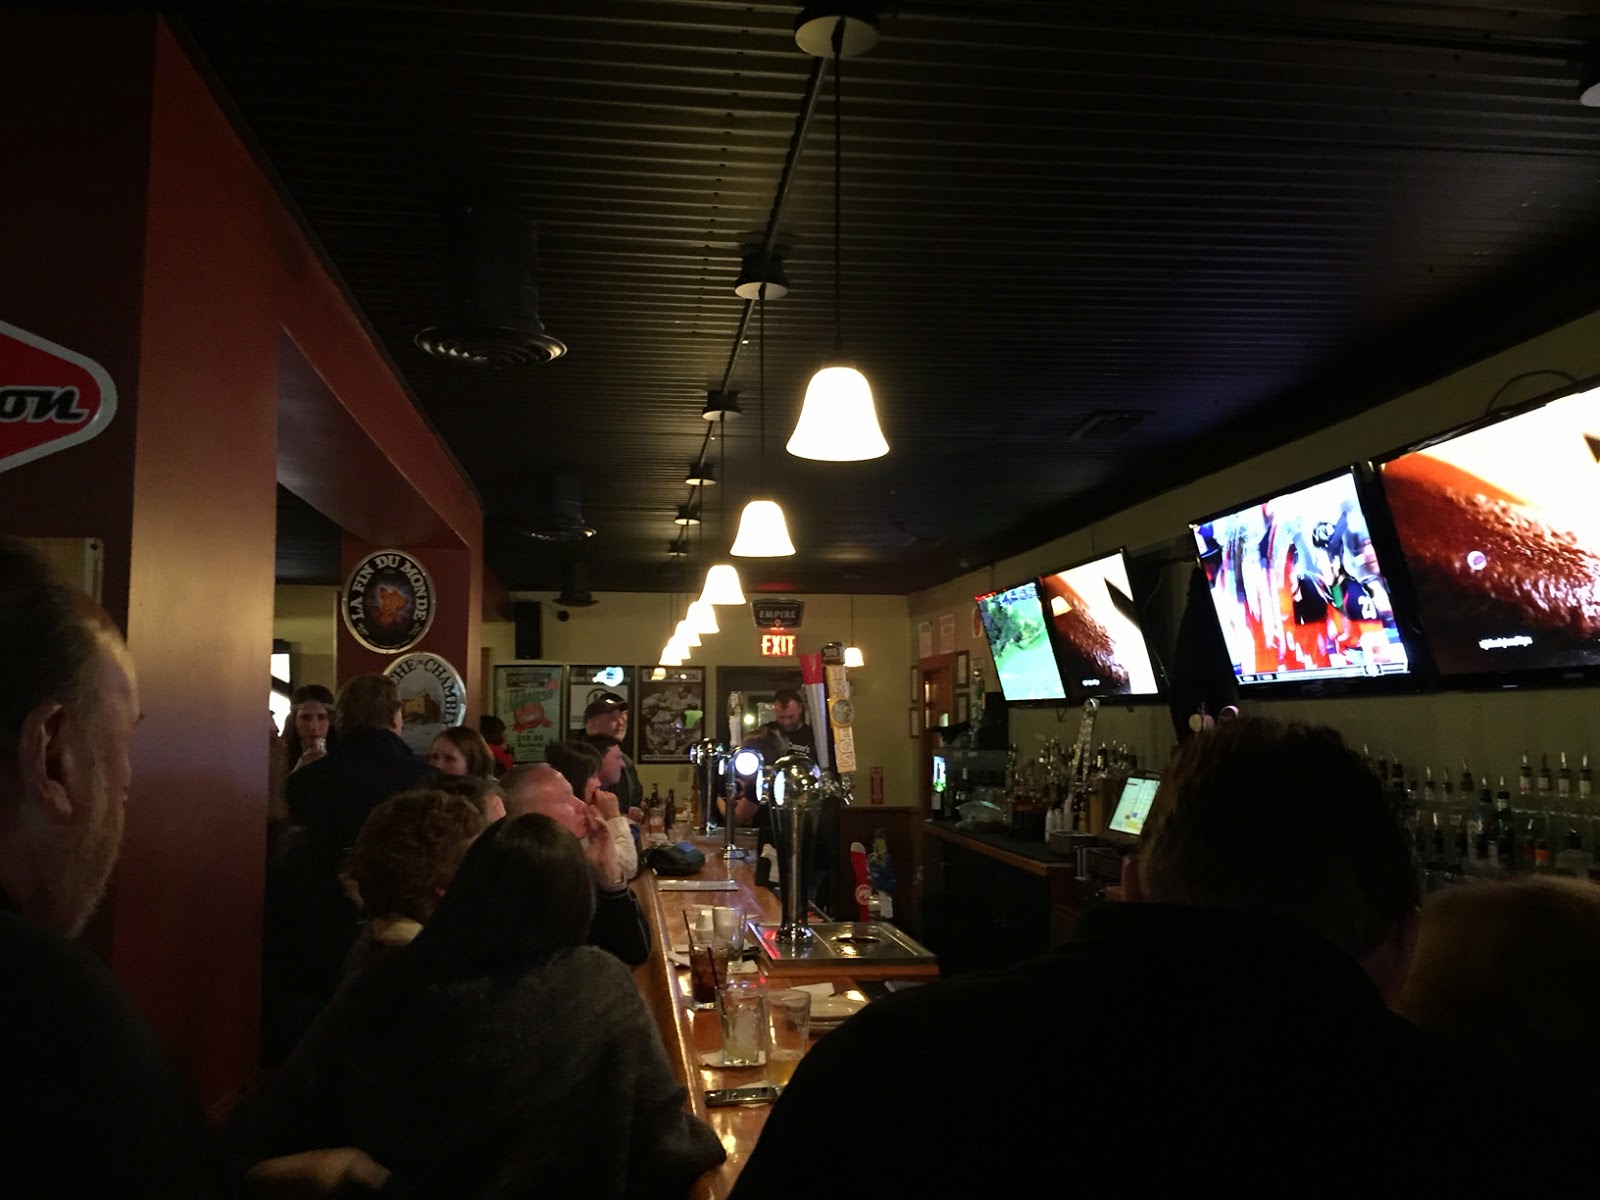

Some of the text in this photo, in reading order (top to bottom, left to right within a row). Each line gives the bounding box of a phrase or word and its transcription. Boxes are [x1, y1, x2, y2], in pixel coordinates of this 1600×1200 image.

[350, 555, 430, 622] LA FIN DU MONDE
[759, 610, 797, 619] EMPIRE
[761, 634, 796, 656] EXIT
